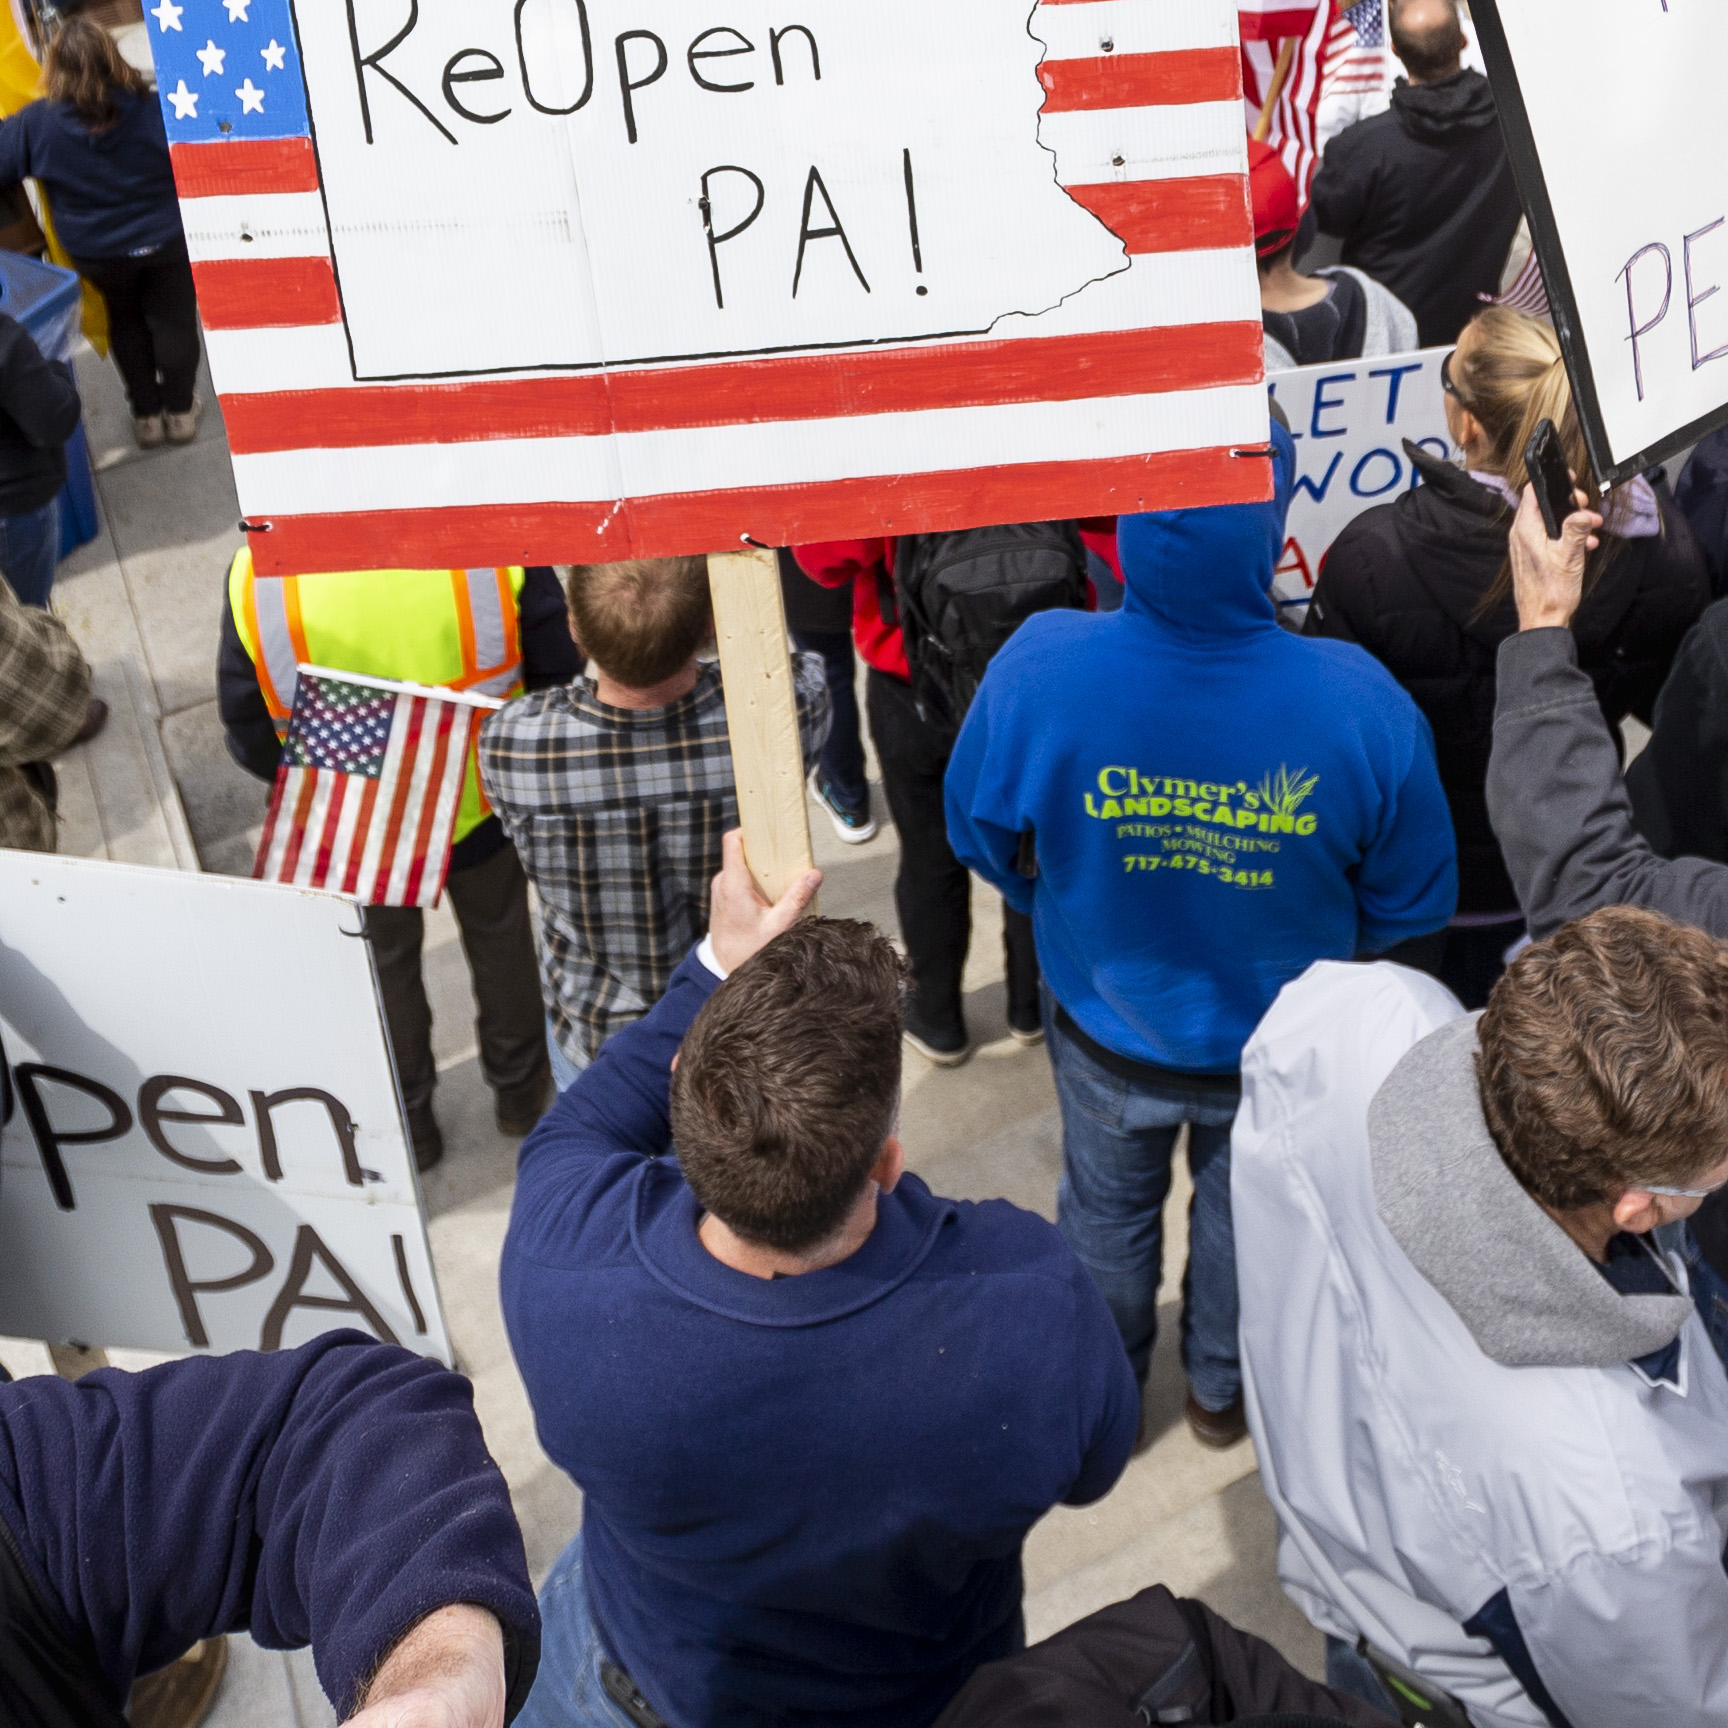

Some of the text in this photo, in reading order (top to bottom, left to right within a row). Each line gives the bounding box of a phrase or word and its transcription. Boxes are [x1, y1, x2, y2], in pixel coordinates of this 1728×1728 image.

[698, 147, 930, 311] PA!
[1096, 763, 1262, 810] Clymer's
[1083, 791, 1318, 836] LANDSCAPING
[1116, 822, 1281, 854] PATIOS MULCHING
[1161, 837, 1237, 865] MOWING
